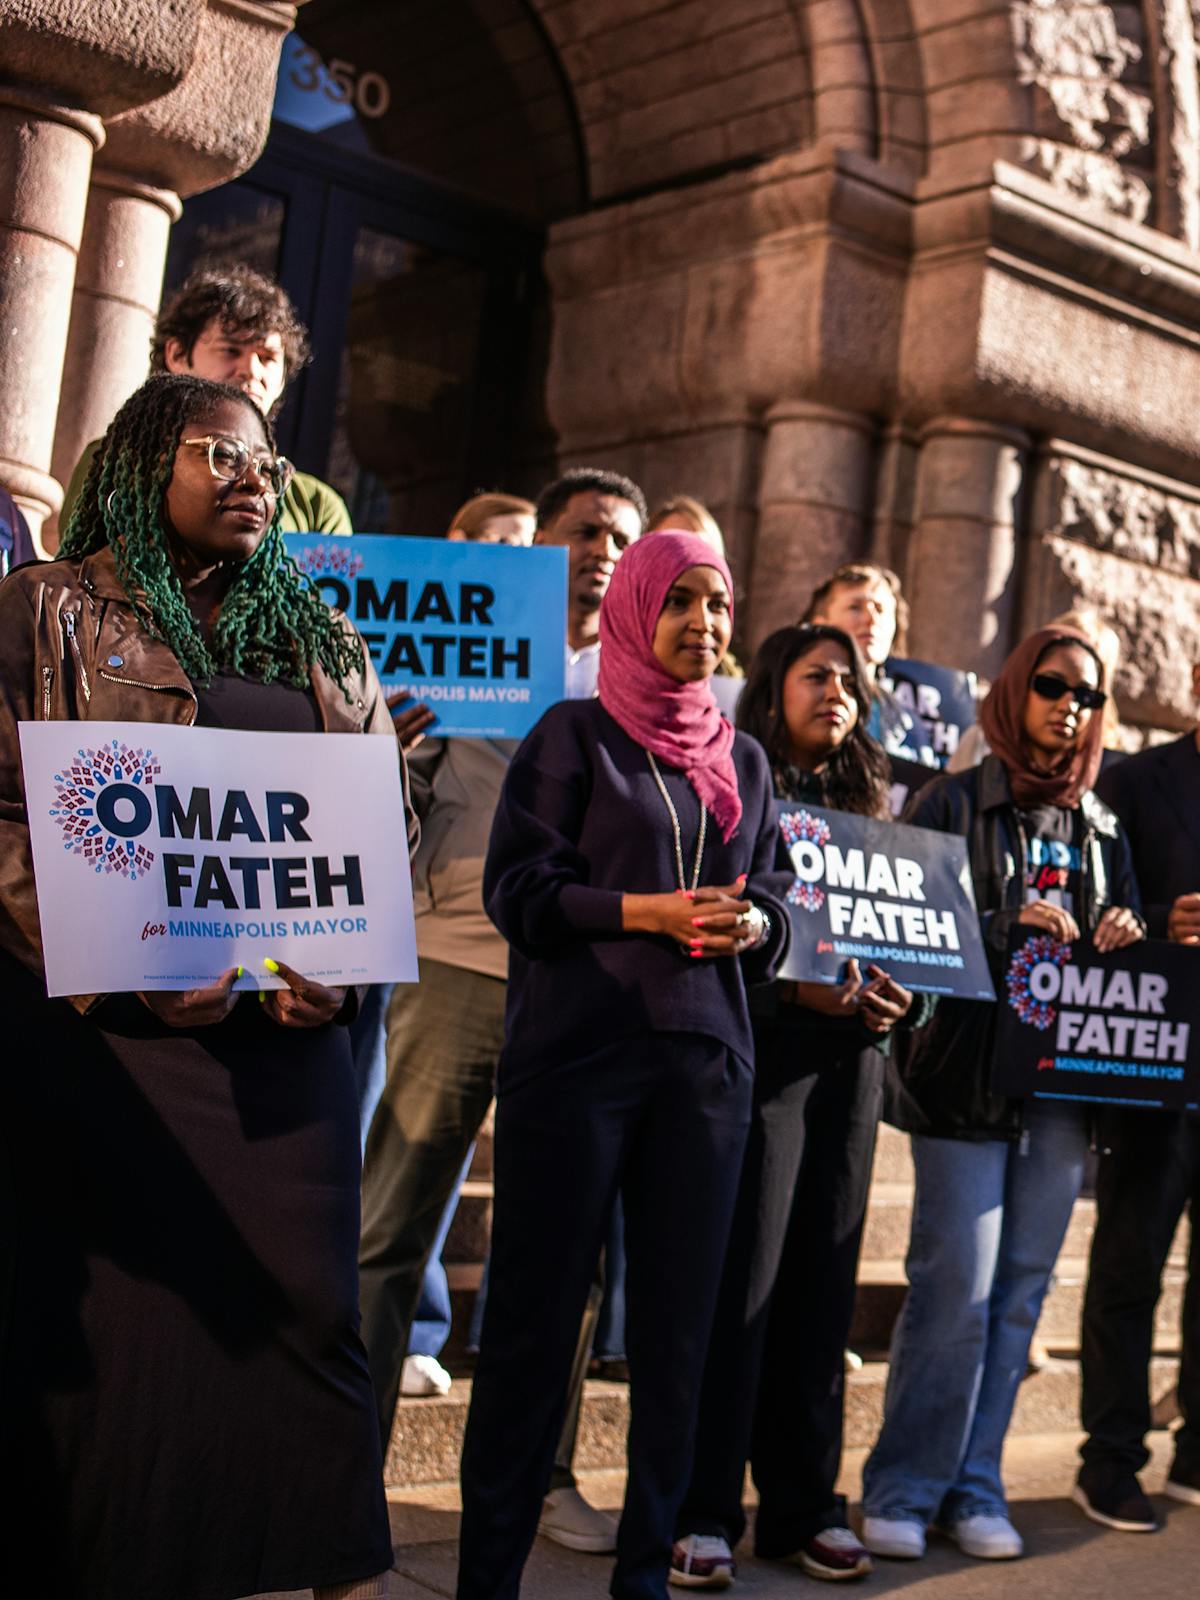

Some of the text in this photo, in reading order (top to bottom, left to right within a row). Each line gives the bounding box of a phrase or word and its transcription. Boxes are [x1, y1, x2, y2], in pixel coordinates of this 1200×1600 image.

[290, 47, 390, 118] 350
[314, 576, 496, 626] OMAR
[382, 683, 531, 703] NEAPOLIS MAYOR
[96, 782, 313, 843] OMAR
[162, 853, 365, 909] FATEH
[790, 839, 926, 902] OMAR
[141, 917, 368, 941] for MINNEAPOLIS MAYOR
[827, 893, 961, 950] FATEH
[833, 940, 918, 964] MINNEAPOLIS
[917, 950, 965, 970] MAYOR
[1029, 960, 1169, 1014] OMAR
[1055, 1010, 1191, 1062] FATEH
